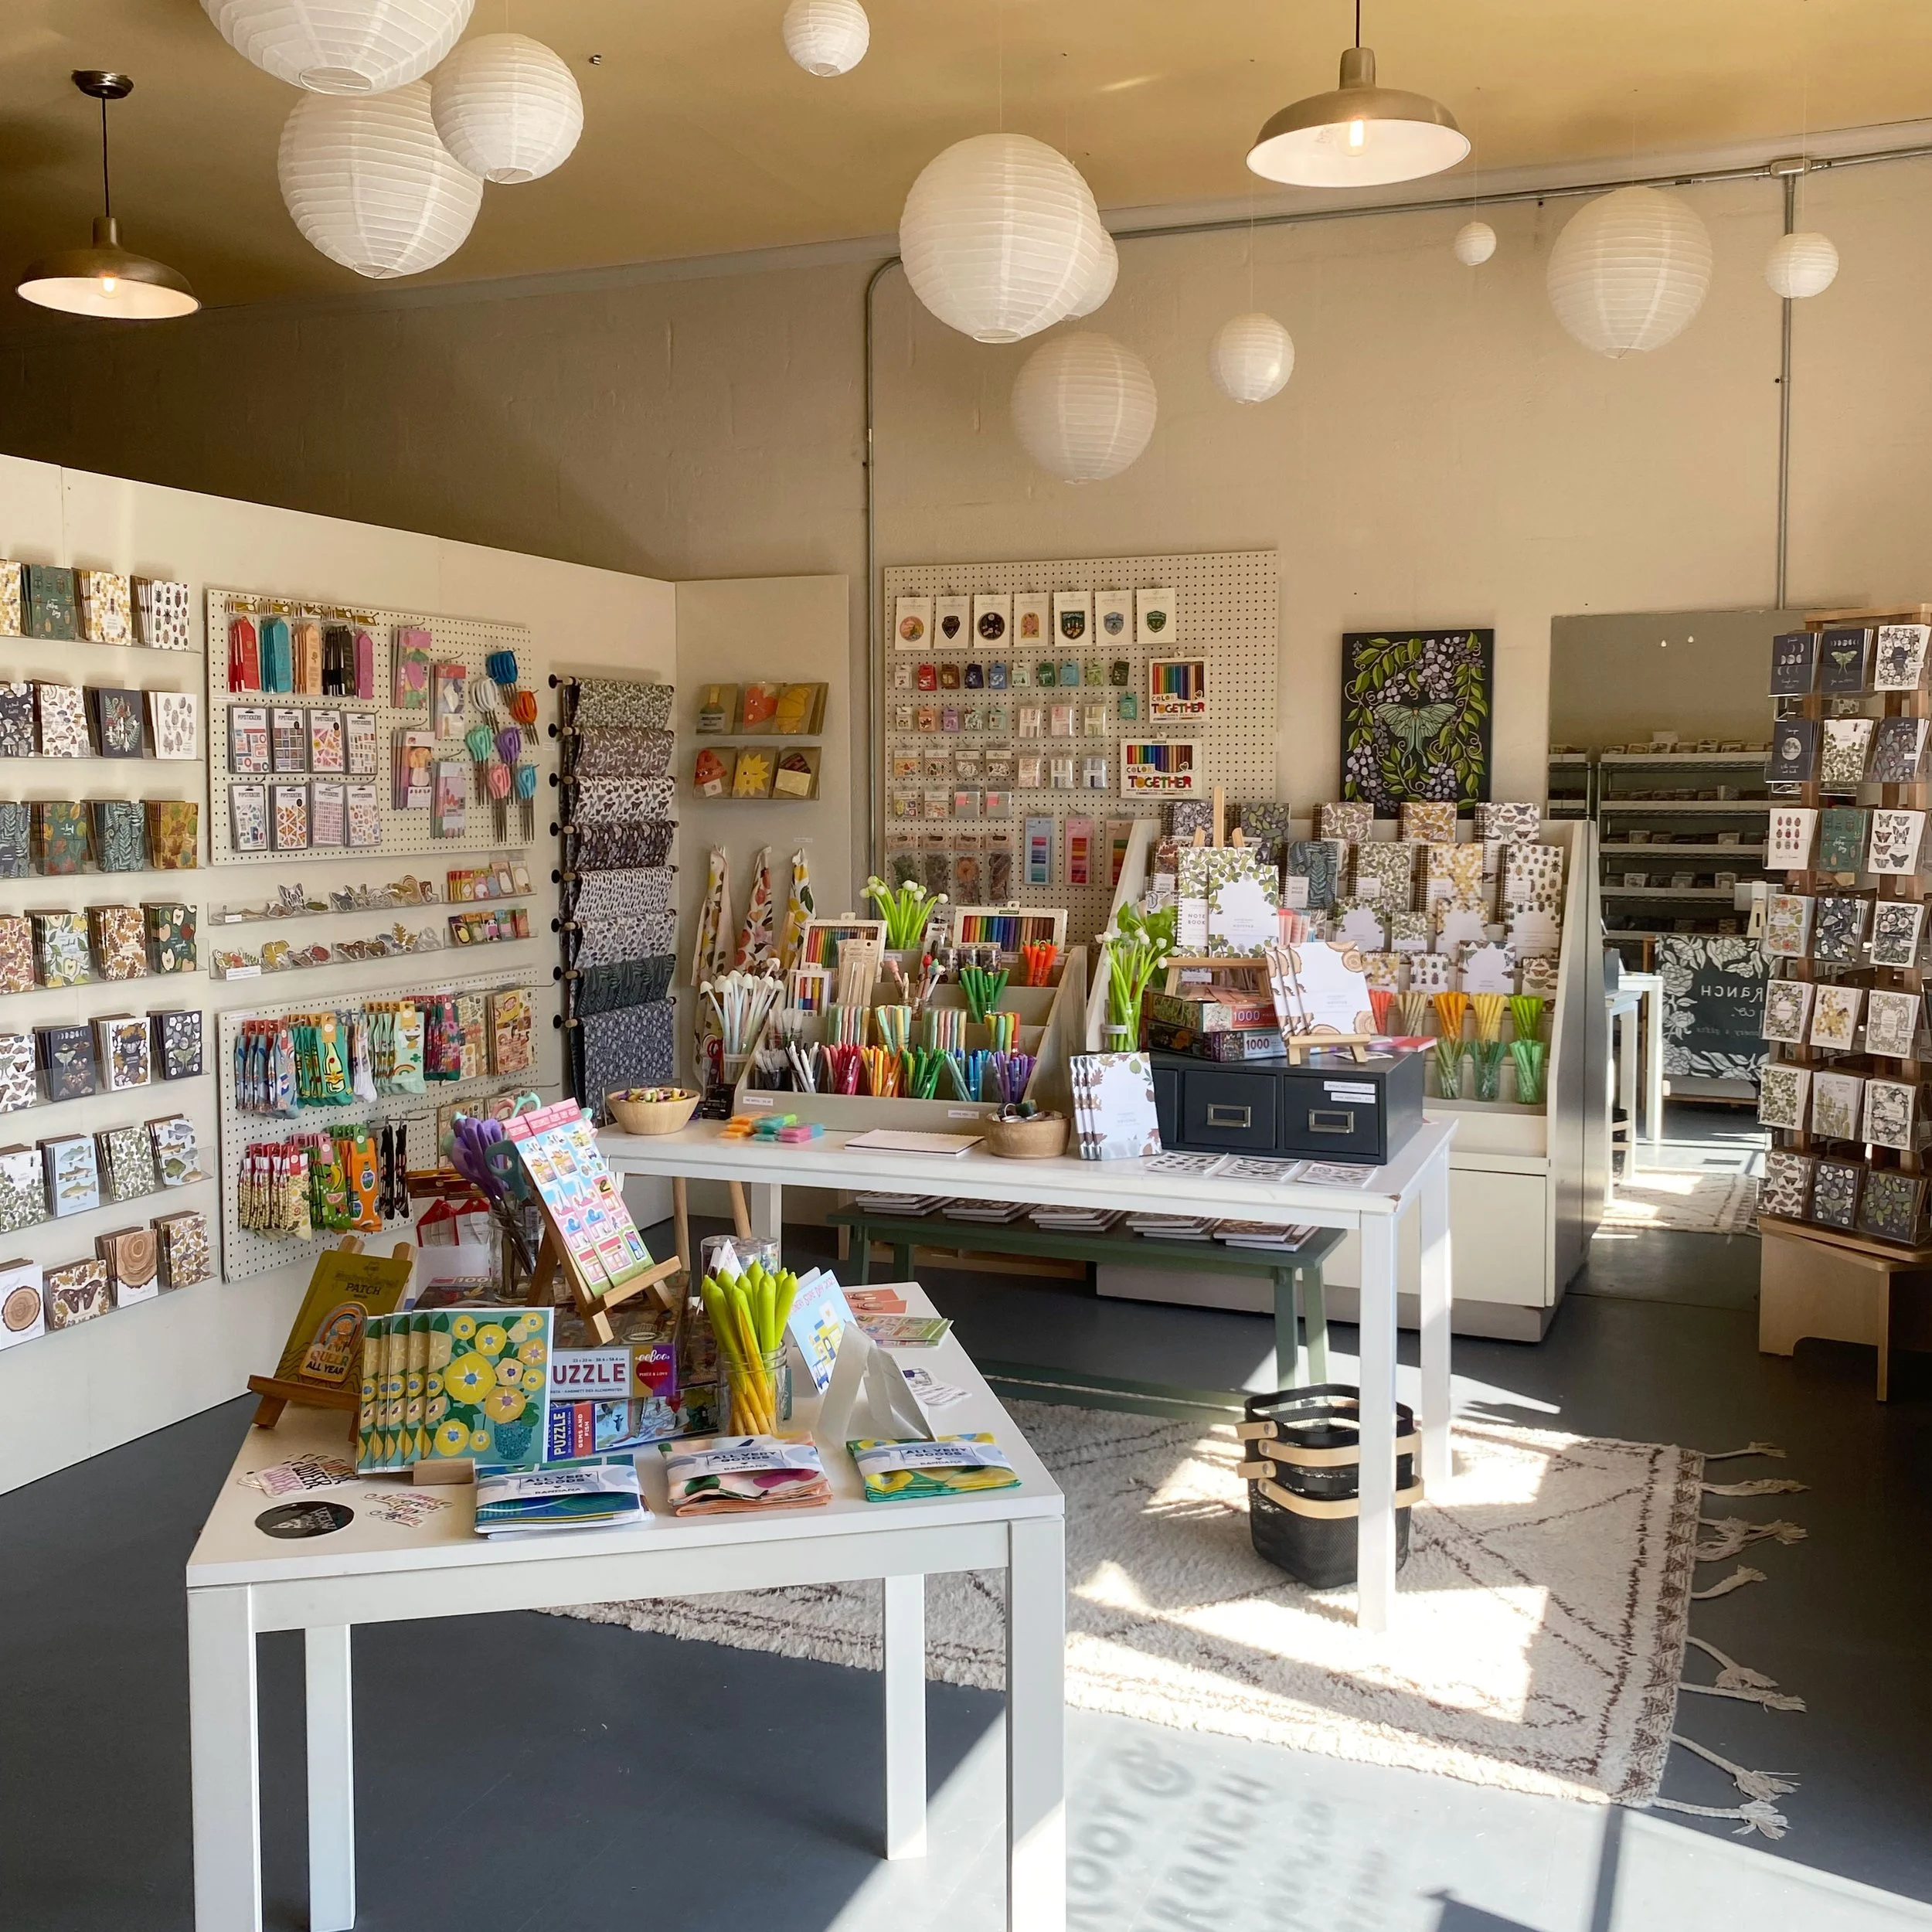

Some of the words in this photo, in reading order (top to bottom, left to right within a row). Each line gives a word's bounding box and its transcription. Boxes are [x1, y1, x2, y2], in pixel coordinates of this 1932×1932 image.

[1151, 702, 1205, 713] TOGETHER
[1128, 775, 1192, 788] TOGETHER
[1233, 1010, 1260, 1022] 1000
[1246, 1038, 1270, 1049] 1000
[345, 1282, 381, 1295] PATCH
[306, 1361, 321, 1371] ALL
[324, 1364, 345, 1375] YEAR
[553, 1363, 626, 1385] UZZLE
[553, 1411, 566, 1456] PUZZLE
[711, 1452, 737, 1461] ALL
[291, 1463, 332, 1491] QUEER
